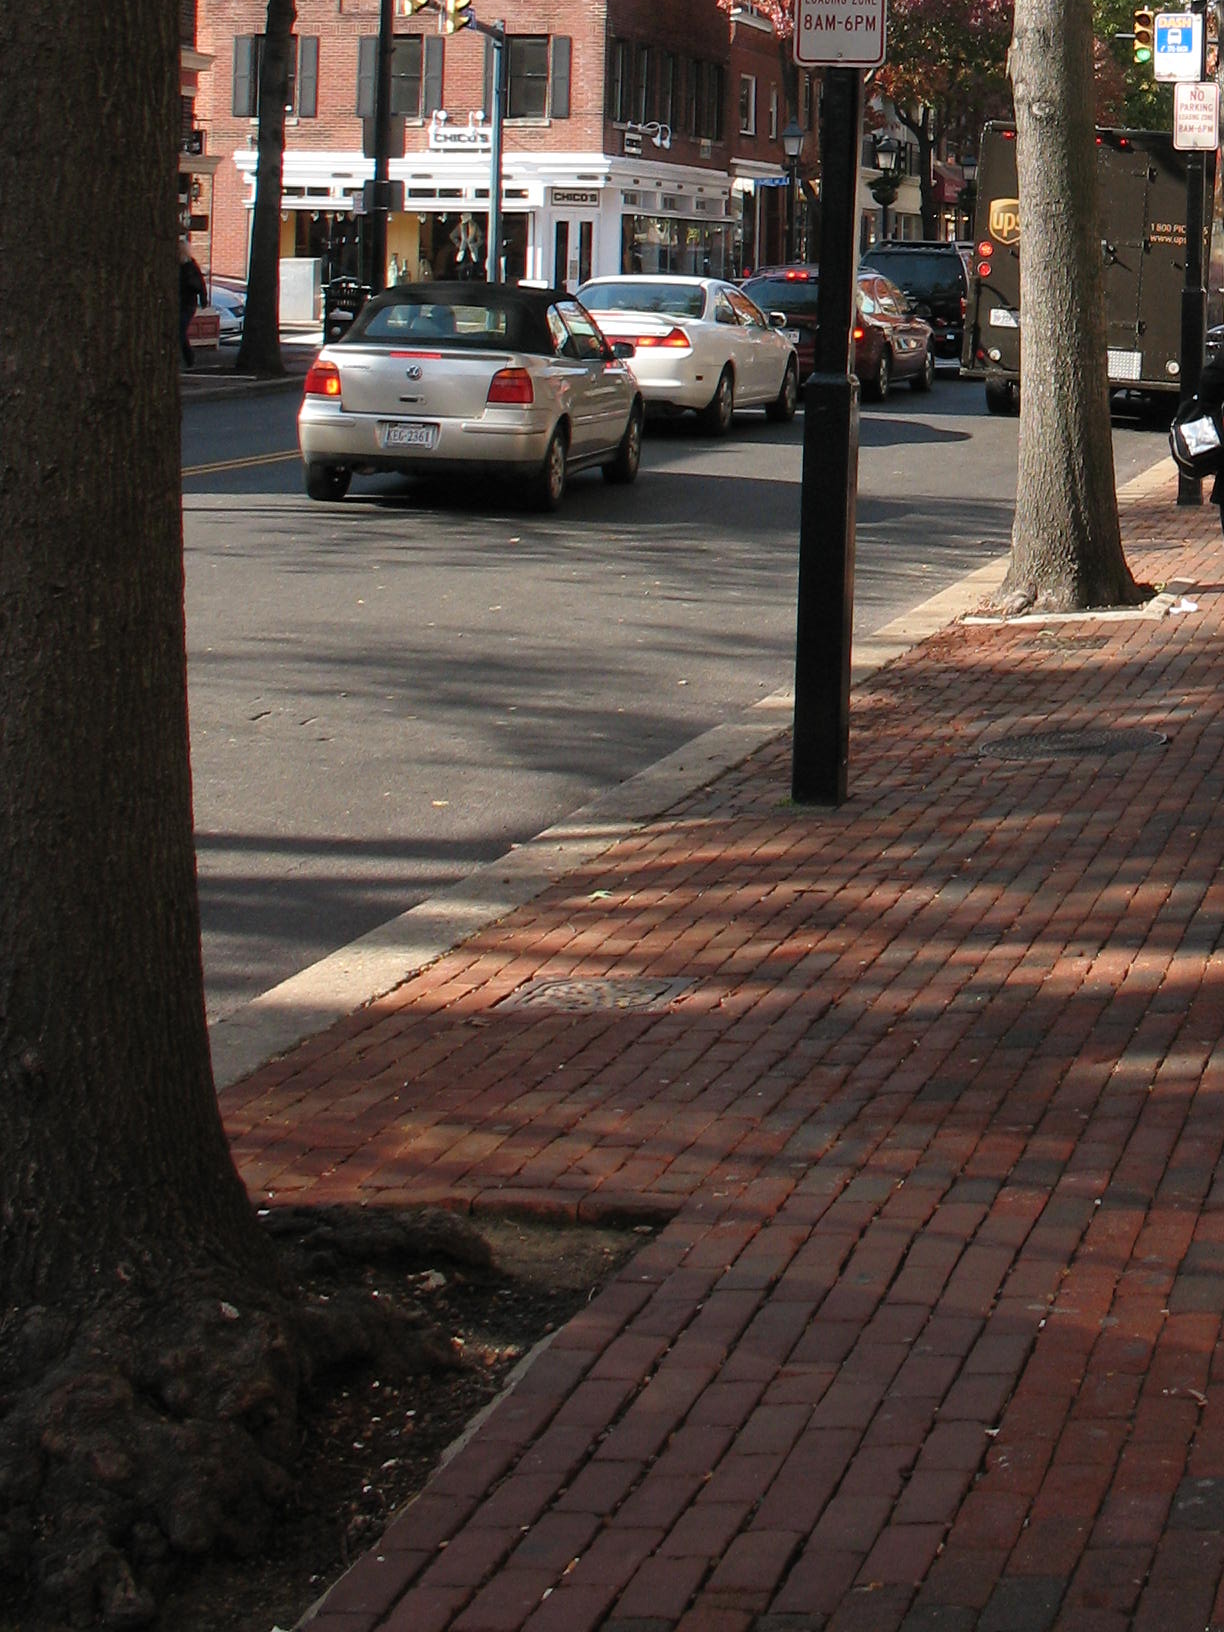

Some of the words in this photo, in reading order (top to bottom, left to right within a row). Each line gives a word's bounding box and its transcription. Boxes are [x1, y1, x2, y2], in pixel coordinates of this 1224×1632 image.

[803, 13, 876, 31] 8AM-6PM
[1158, 16, 1192, 28] DASH
[1189, 90, 1205, 102] NO
[1179, 103, 1213, 112] PARKING
[1178, 124, 1213, 133] 8AM-6PM
[434, 132, 490, 143] CHICO'S
[553, 191, 598, 202] CHICO'S
[1156, 223, 1172, 233] 800
